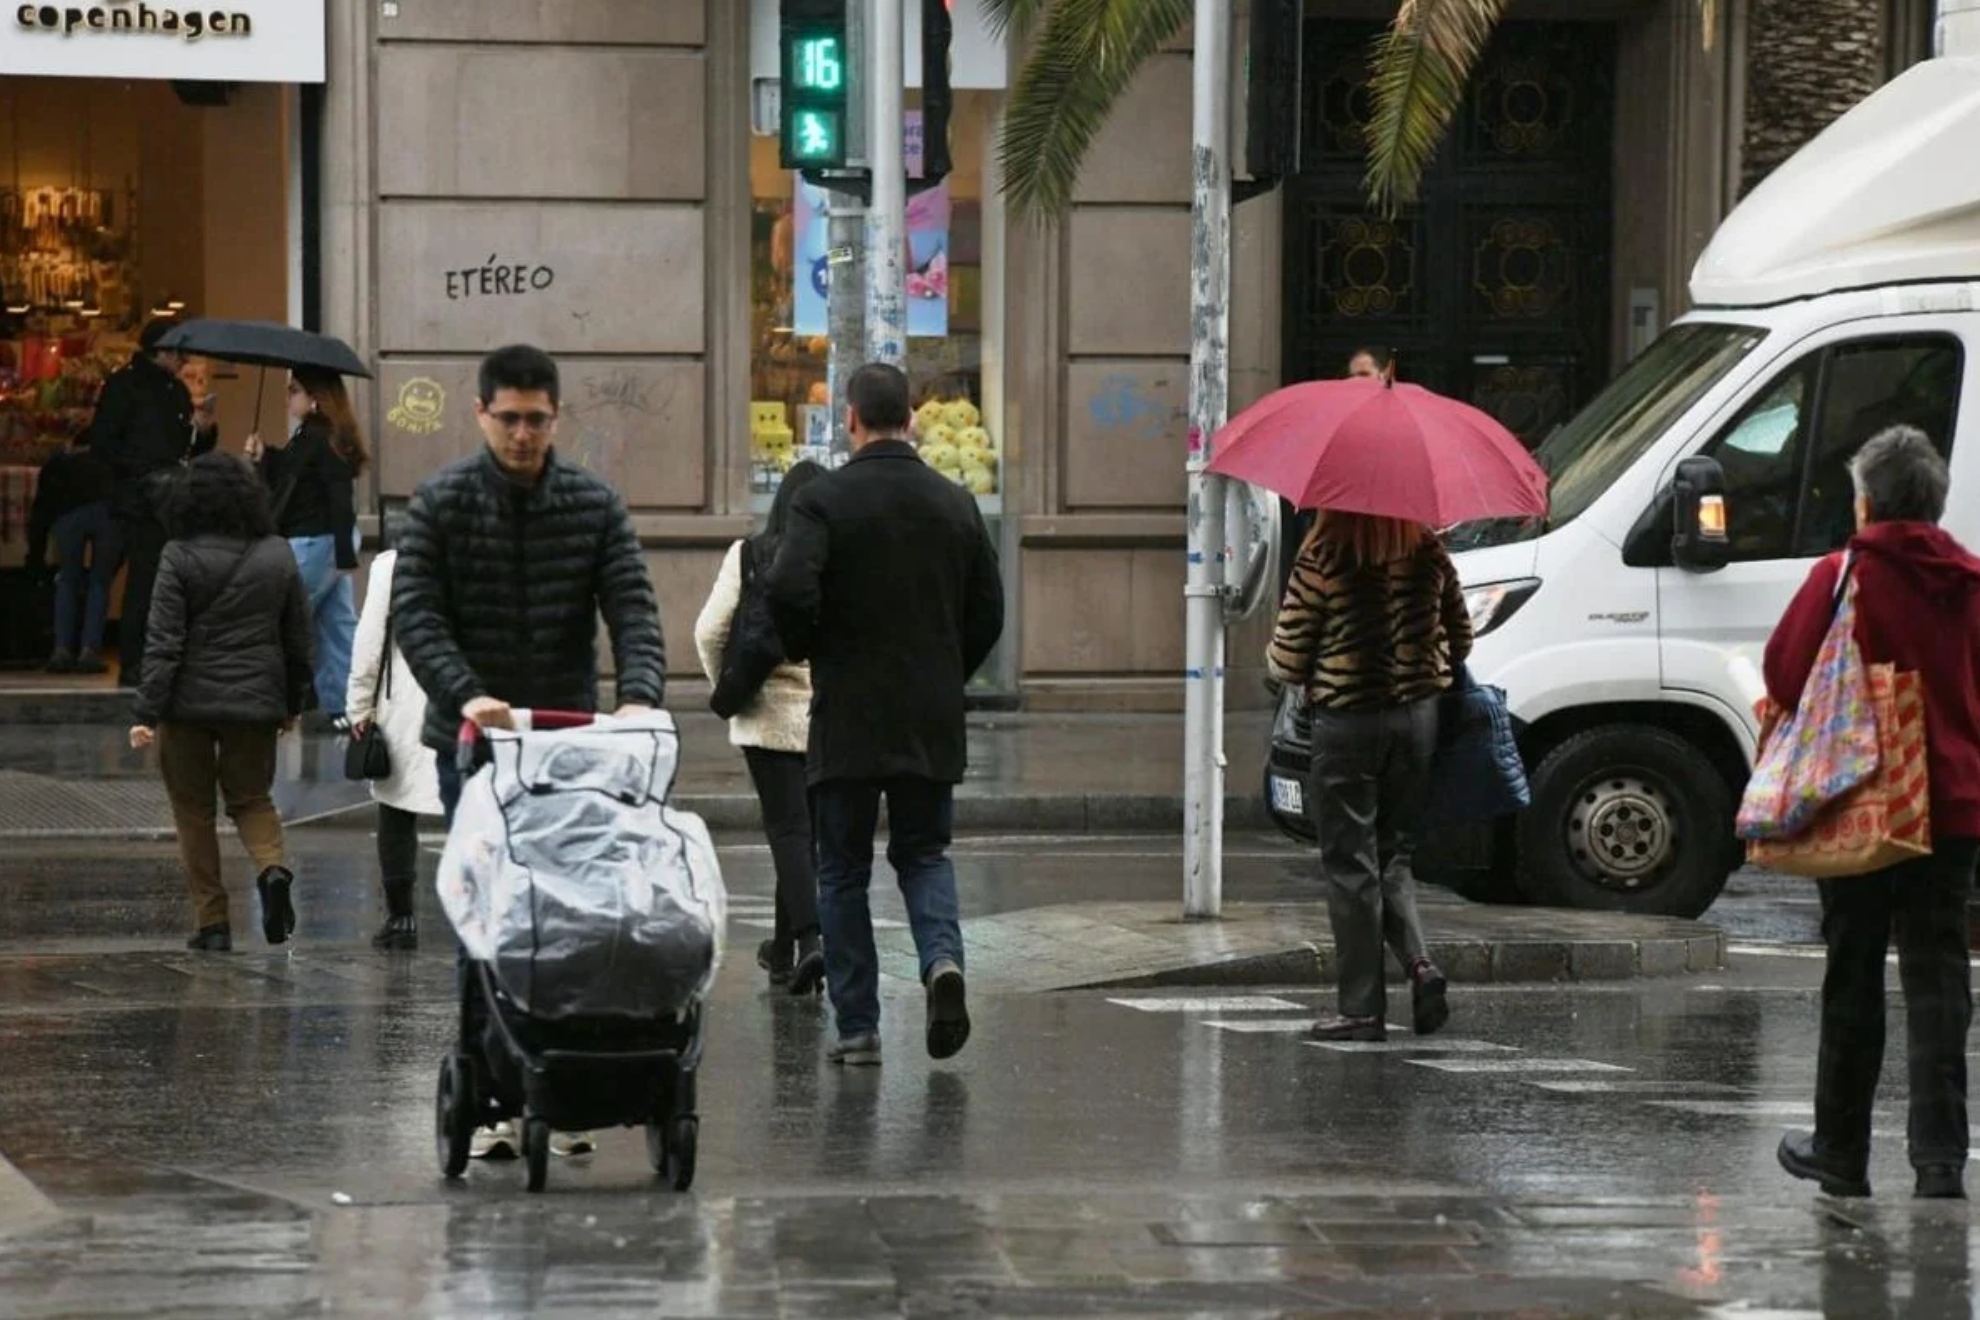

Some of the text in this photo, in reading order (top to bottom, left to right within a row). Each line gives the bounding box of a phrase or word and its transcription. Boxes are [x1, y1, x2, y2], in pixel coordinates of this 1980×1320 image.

[17, 3, 252, 38] copenhagen
[804, 37, 840, 89] 16
[445, 253, 554, 300] ETÉREO
